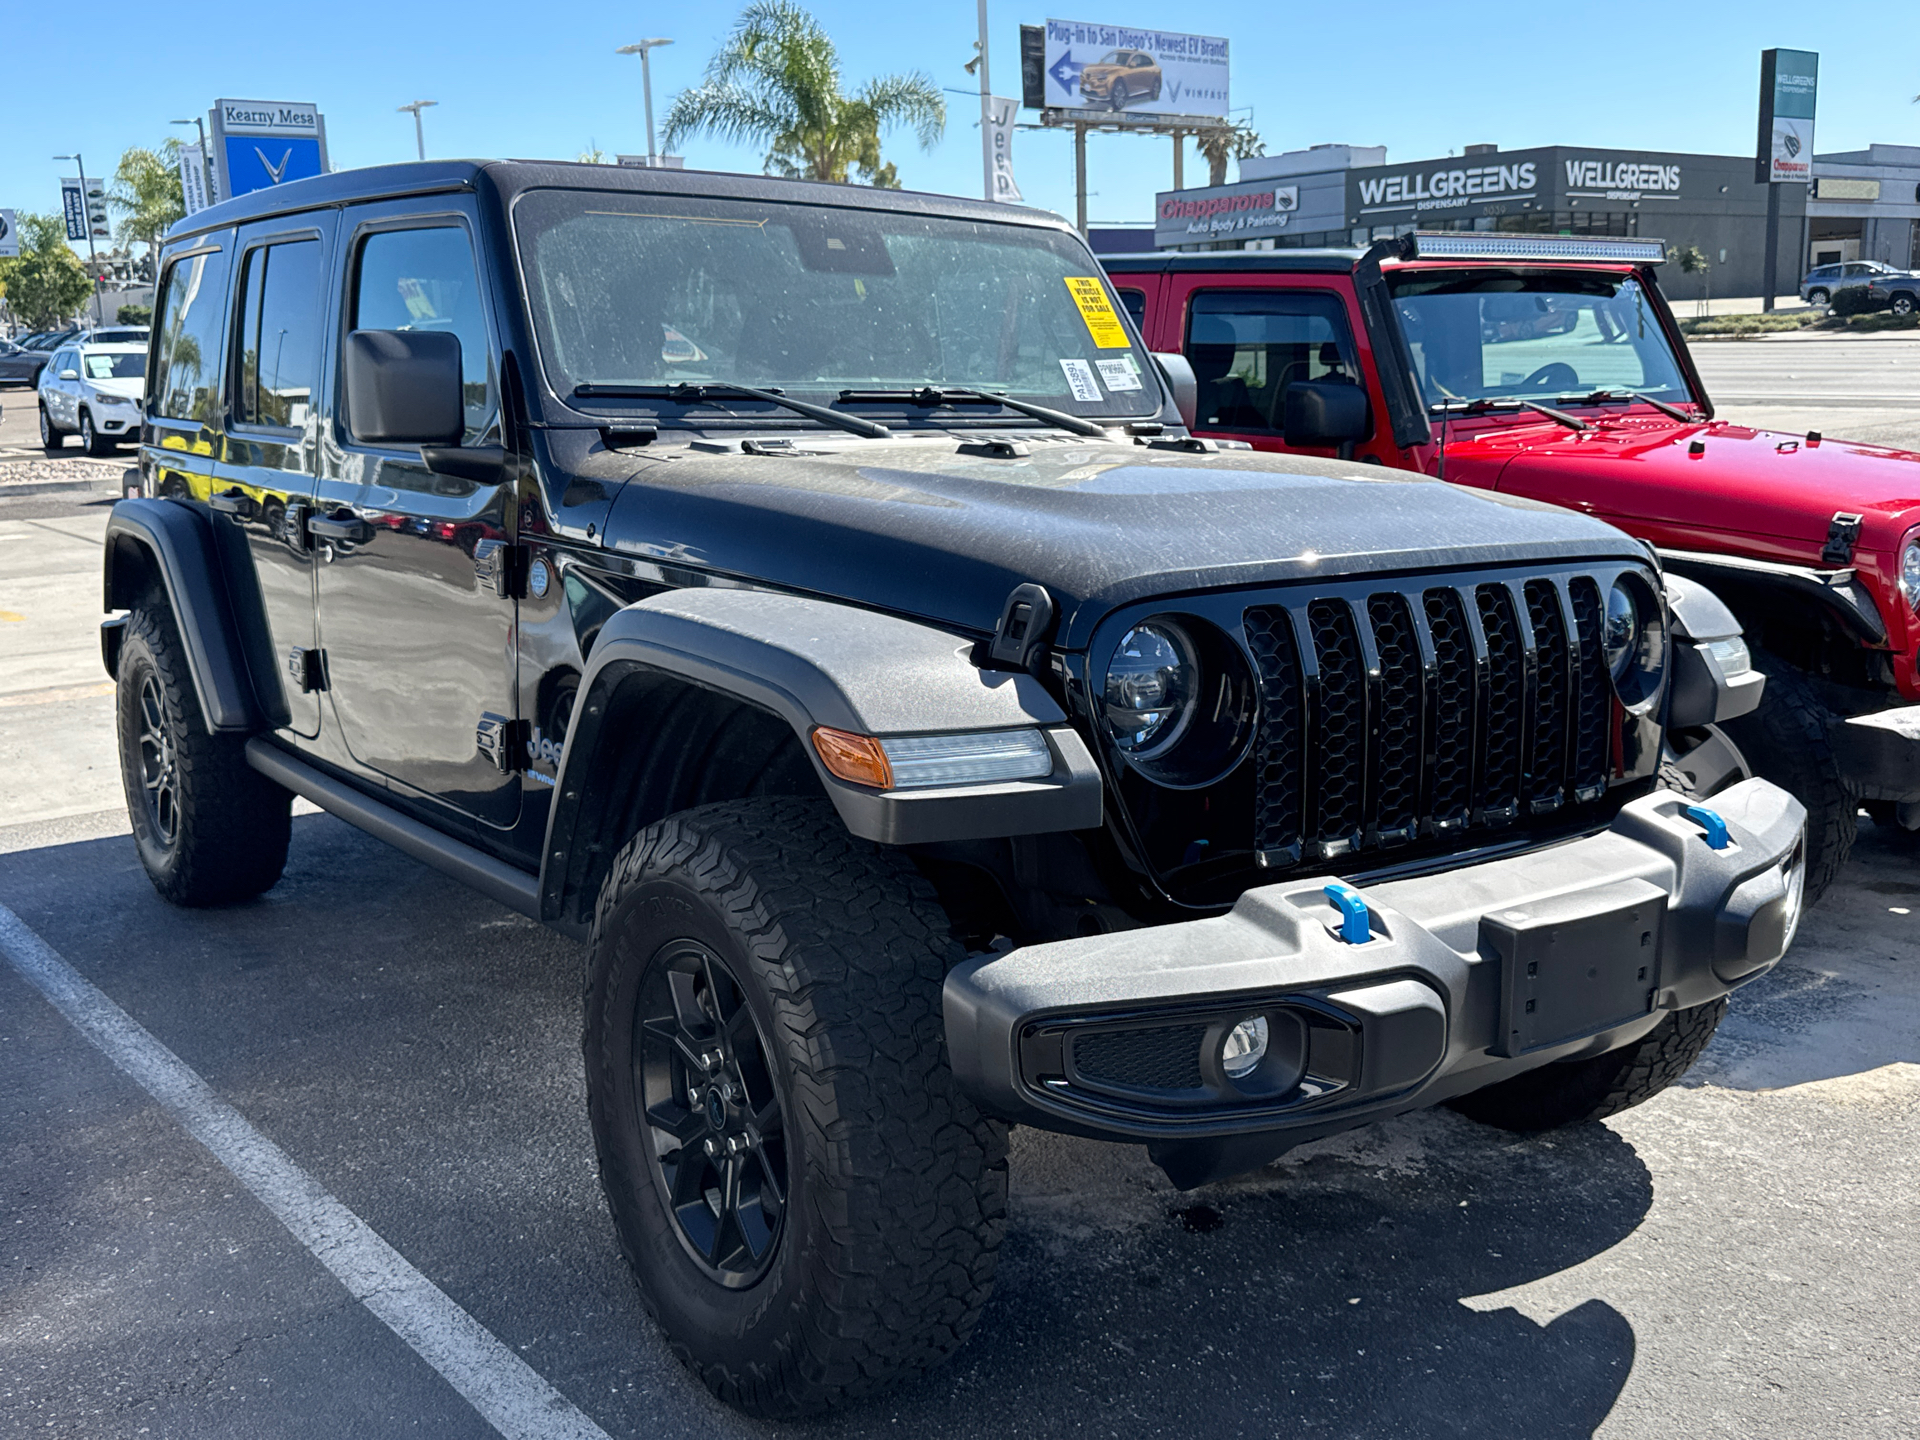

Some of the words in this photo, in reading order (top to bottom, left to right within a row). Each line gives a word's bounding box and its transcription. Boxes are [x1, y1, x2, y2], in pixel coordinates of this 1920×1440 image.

[1048, 22, 1086, 45] Plug-in
[1087, 26, 1097, 45] to
[1099, 27, 1116, 47] San
[1118, 30, 1153, 50] Diego's
[1155, 35, 1187, 54] Newest
[1188, 37, 1199, 55] EV
[1201, 39, 1228, 58] Brand!
[1776, 74, 1815, 86] WELLGREENS
[1185, 88, 1228, 100] VINFAST
[225, 107, 275, 127] Kearny
[279, 109, 314, 124] Mesa
[995, 105, 1009, 194] Jeep
[1359, 162, 1537, 205] WELLGREENS
[1565, 160, 1680, 191] WELLGREENS
[72, 192, 81, 213] EASY
[1417, 197, 1470, 211] DISPENSARY
[1606, 190, 1641, 200] DISPENSARY
[64, 191, 74, 220] BUYING
[1161, 192, 1274, 219] Chapparone
[68, 220, 76, 238] CAR
[75, 214, 84, 237] MADE
[1186, 223, 1209, 234] Auto
[1210, 218, 1236, 233] Body
[1237, 220, 1245, 229] &
[1246, 214, 1289, 228] Painting
[1074, 288, 1101, 296] VEHICLE
[1075, 279, 1092, 287] THIS
[1081, 296, 1089, 304] IS
[1089, 296, 1102, 304] NOT
[1081, 305, 1095, 313] FOR
[1095, 305, 1111, 313] SALE
[1066, 362, 1088, 400] PA13891
[526, 726, 564, 767] Jee
